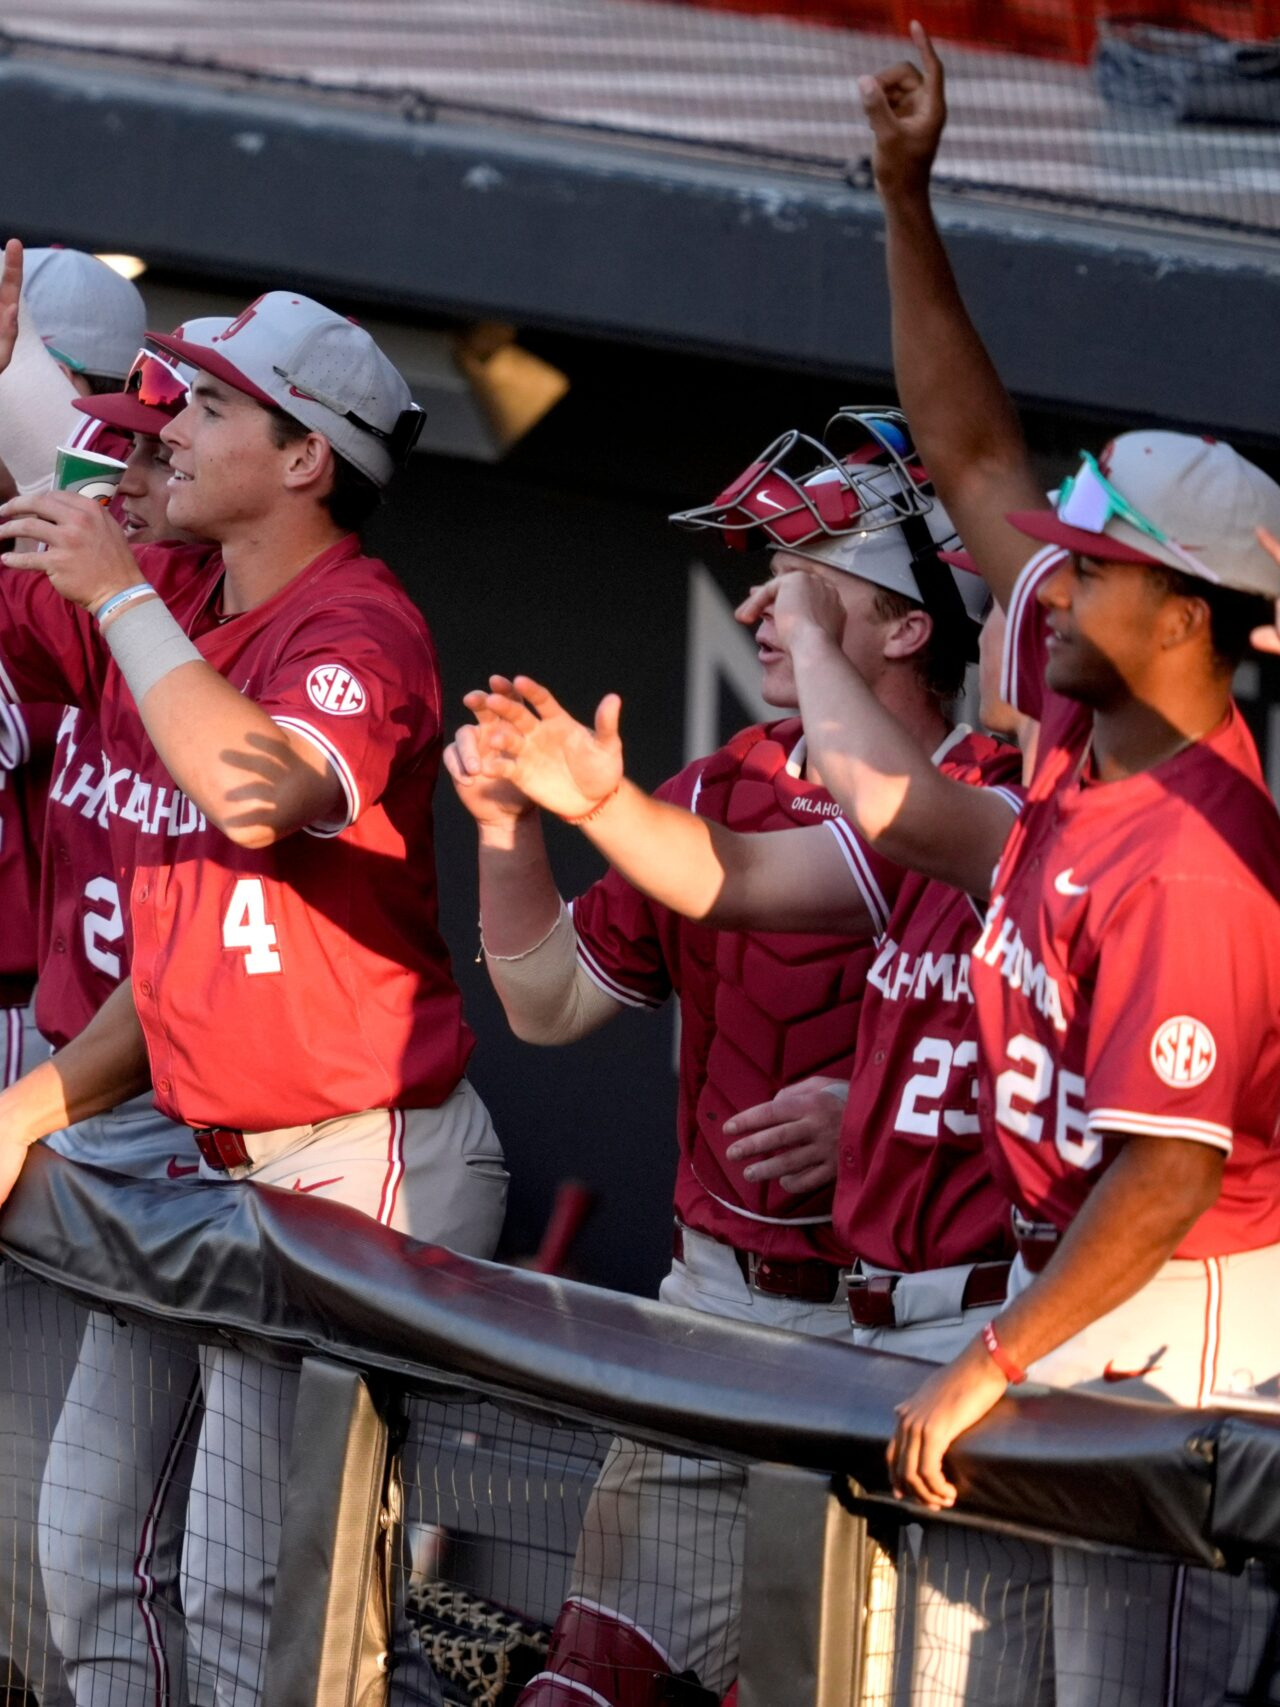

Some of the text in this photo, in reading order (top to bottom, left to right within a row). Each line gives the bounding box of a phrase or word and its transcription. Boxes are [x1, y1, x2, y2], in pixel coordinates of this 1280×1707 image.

[309, 666, 364, 713] SEC
[790, 796, 844, 817] OKLAHO
[222, 877, 282, 975] 4
[1155, 1020, 1214, 1081] SEC
[994, 1033, 1104, 1171] 26
